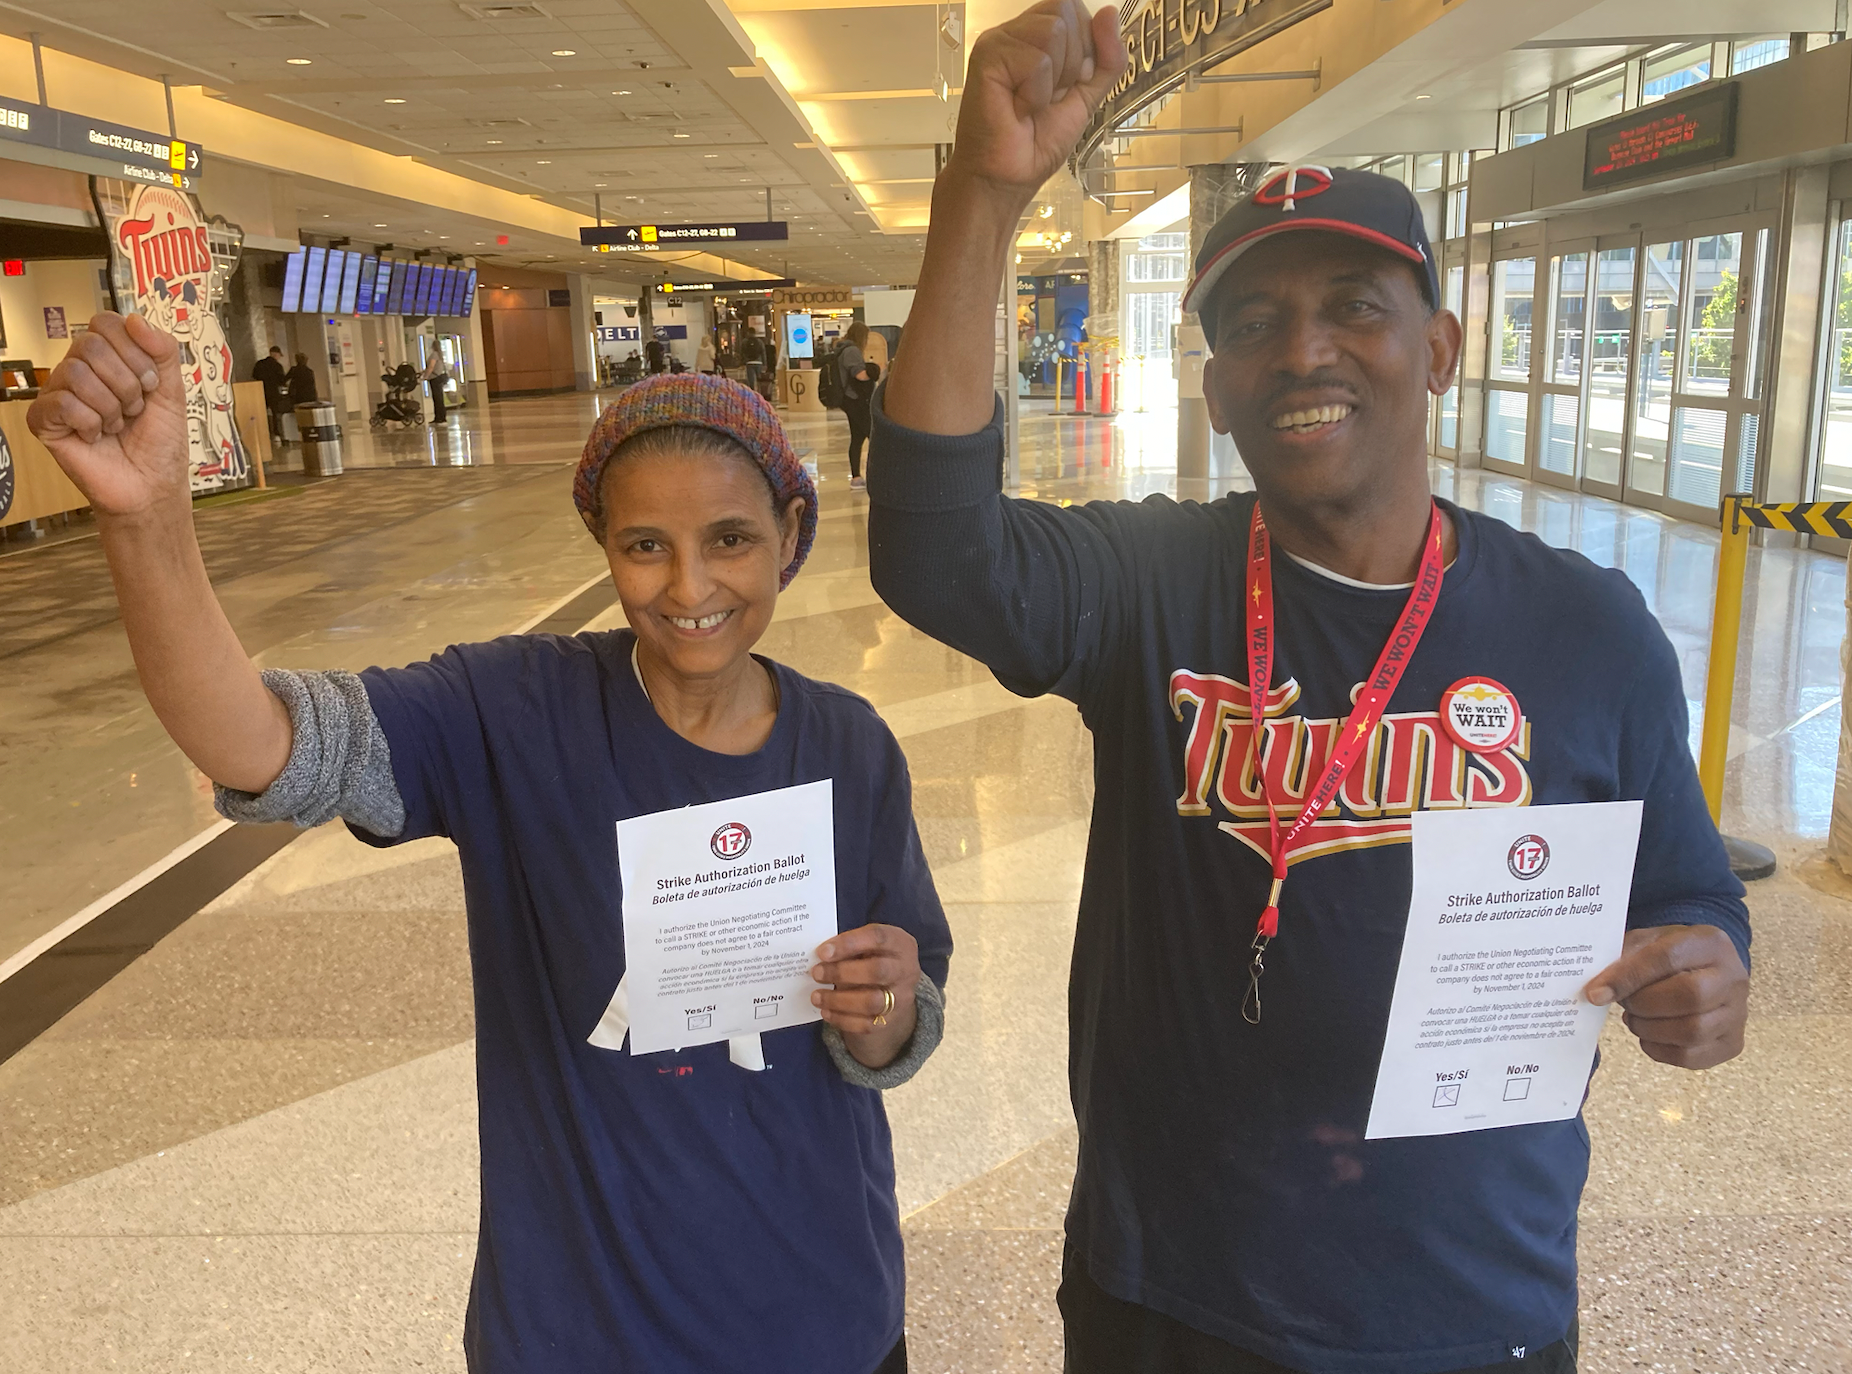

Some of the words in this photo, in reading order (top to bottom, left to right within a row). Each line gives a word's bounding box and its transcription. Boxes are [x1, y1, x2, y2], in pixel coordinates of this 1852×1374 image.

[89, 130, 109, 146] Gates
[124, 165, 142, 177] Airline
[142, 168, 156, 181] Club
[159, 172, 174, 184] Delta
[120, 211, 211, 298] Twins
[645, 243, 659, 251] Delta
[772, 289, 849, 306] Chiropractor
[1372, 663, 1398, 691] WE
[1386, 604, 1426, 662] WON'T
[1416, 562, 1439, 603] WAIT
[1253, 626, 1267, 652] WE
[1453, 703, 1472, 713] We
[1475, 705, 1508, 714] won't
[1456, 714, 1507, 728] WAIT
[1170, 668, 1533, 818] Twins
[719, 832, 743, 852] 17
[1517, 848, 1541, 869] 17
[656, 875, 691, 890] Strike
[693, 861, 770, 883] Authorization
[773, 853, 804, 869] Ballot
[652, 891, 684, 905] Boleta
[687, 888, 699, 898] de
[701, 877, 762, 896] autorización
[764, 875, 776, 885] de
[778, 869, 810, 882] huelga
[1447, 893, 1482, 907] Strike
[1484, 888, 1564, 904] Authorization
[1566, 885, 1600, 899] Ballot
[663, 923, 696, 934] authorize
[697, 920, 708, 928] the
[709, 918, 730, 926] Union
[731, 911, 770, 923] Negotiating
[771, 905, 806, 915] Committee
[1438, 912, 1472, 924] Boleta
[1474, 910, 1487, 921] de
[1489, 905, 1552, 920] autorización
[1554, 904, 1567, 915] de
[1569, 901, 1603, 914] huelga
[663, 935, 676, 943] call
[683, 930, 708, 940] STRIKE
[717, 926, 735, 934] other
[737, 920, 770, 931] economic
[771, 917, 792, 926] action
[663, 942, 695, 952] company
[696, 939, 713, 947] does
[715, 936, 726, 944] not
[727, 934, 747, 944] agree
[762, 929, 774, 937] fair
[775, 925, 802, 935] contract
[711, 944, 746, 954] November
[753, 940, 769, 948] 2024
[1441, 951, 1475, 961] authorize
[1476, 950, 1489, 959] the
[1490, 949, 1511, 958] Union
[1512, 946, 1553, 958] Negotiating
[1555, 944, 1592, 954] Committee
[1439, 963, 1453, 972] call
[1460, 962, 1485, 971] STRIKE
[1495, 960, 1514, 969] other
[1516, 958, 1551, 968] economic
[1552, 957, 1574, 966] action
[1581, 955, 1593, 964] the
[1436, 976, 1470, 985] company
[1471, 974, 1489, 982] does
[1490, 972, 1502, 981] not
[1503, 973, 1524, 982] agree
[1540, 970, 1552, 978] fair
[1553, 968, 1583, 977] contract
[1483, 983, 1520, 992] November
[1527, 982, 1544, 990] 2024
[753, 996, 784, 1005] No/No
[684, 1005, 717, 1015] Yes/Sí
[1436, 1069, 1470, 1082] Yes/Sí
[1506, 1064, 1540, 1076] No/No
